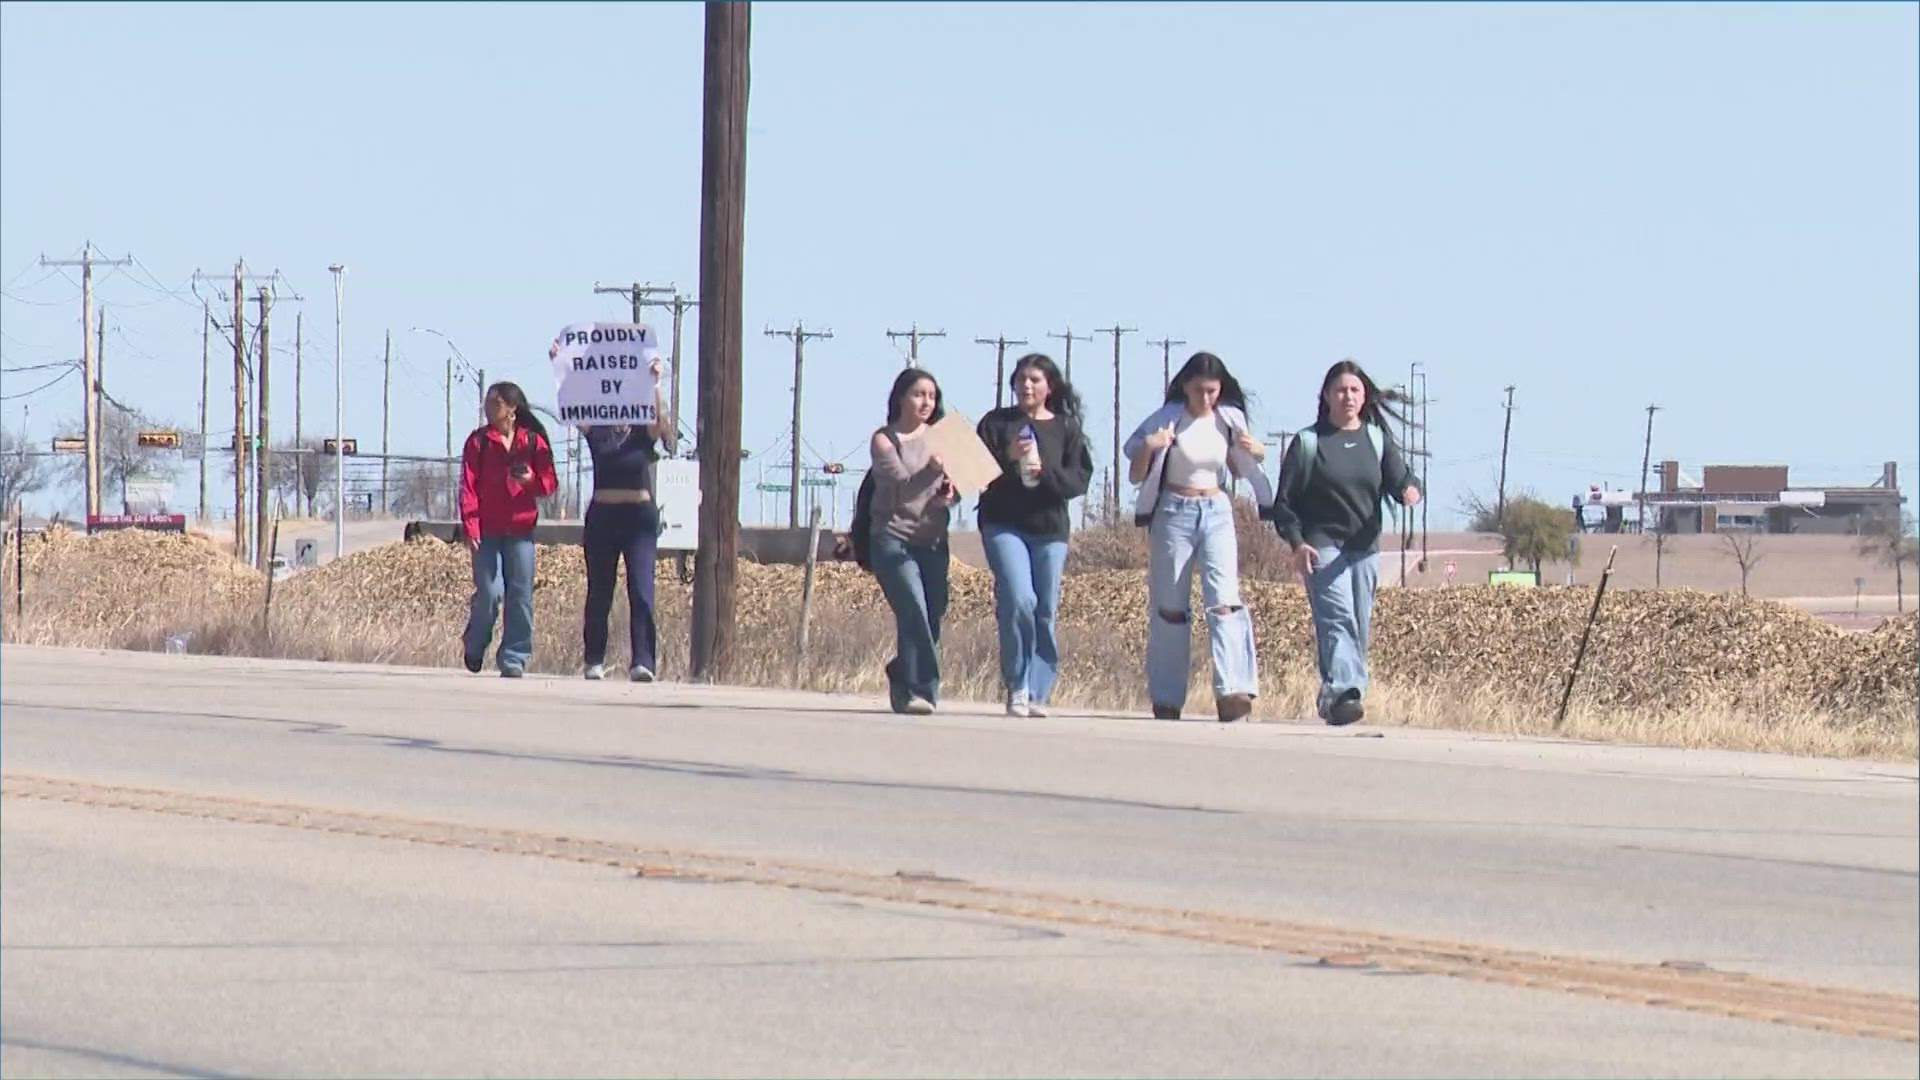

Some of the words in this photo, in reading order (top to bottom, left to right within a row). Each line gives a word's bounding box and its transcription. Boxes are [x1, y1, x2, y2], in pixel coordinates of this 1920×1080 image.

[565, 329, 646, 346] PROUDLY
[573, 355, 638, 372] RAISED
[601, 379, 622, 394] BY
[561, 405, 656, 421] IMMIGRANTS
